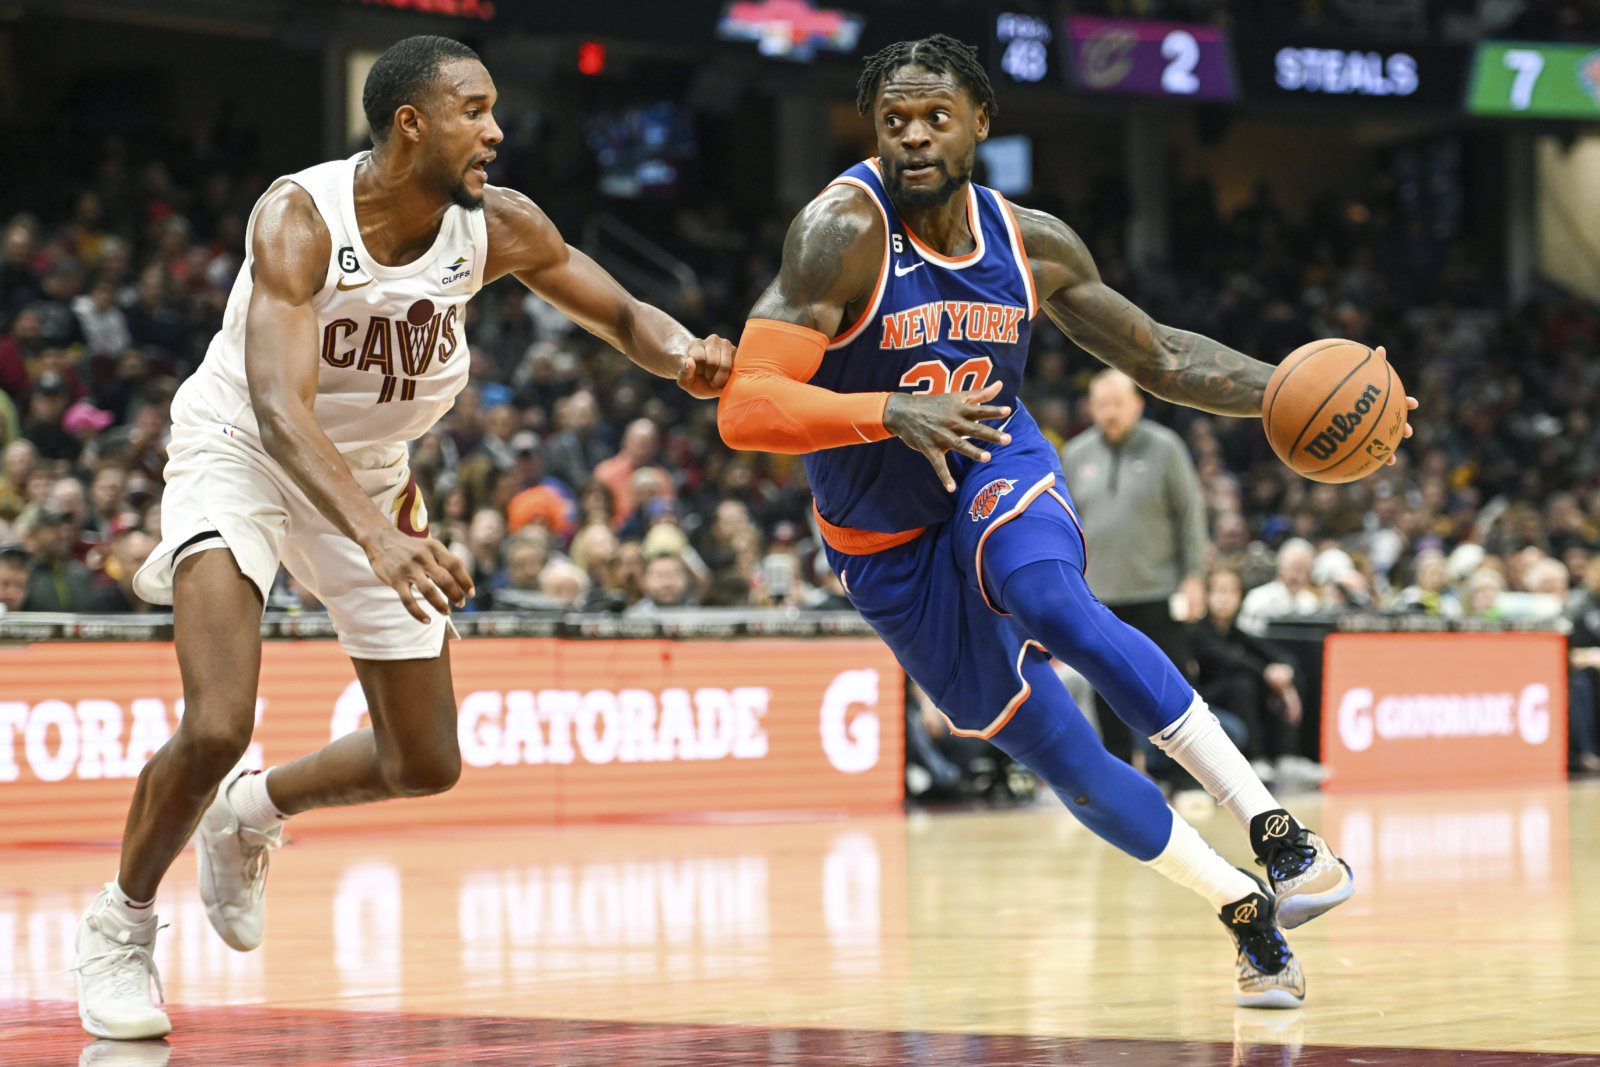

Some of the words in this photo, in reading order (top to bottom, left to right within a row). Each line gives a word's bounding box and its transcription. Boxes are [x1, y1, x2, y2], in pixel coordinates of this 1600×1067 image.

[1160, 30, 1200, 94] 2
[1274, 47, 1419, 96] STEALS
[1503, 50, 1545, 111] 7
[342, 250, 356, 270] 6
[892, 233, 904, 253] 6
[441, 269, 471, 285] CLIFFS
[321, 302, 457, 377] CAVS
[879, 300, 944, 350] NEW
[944, 300, 1026, 345] YORK
[376, 375, 417, 405] 11
[1303, 383, 1382, 461] Wilson
[457, 687, 770, 767] GATORADE
[820, 668, 879, 773] G
[1338, 688, 1373, 751] G
[1518, 683, 1549, 745] G
